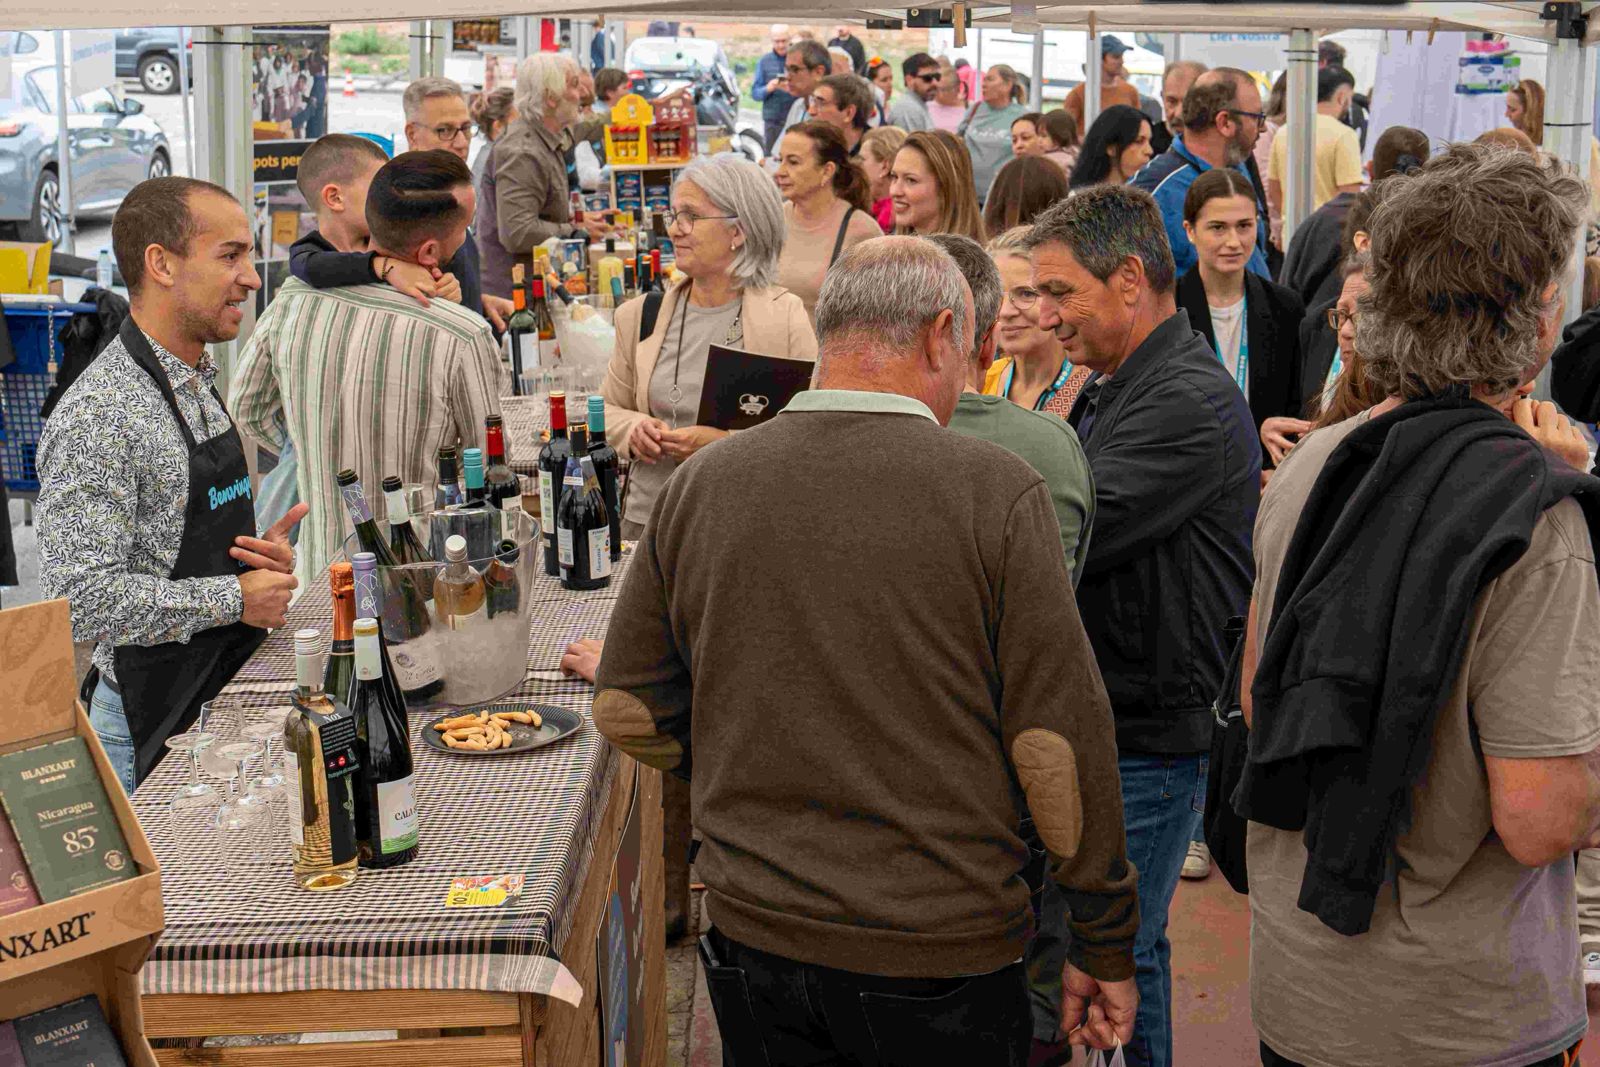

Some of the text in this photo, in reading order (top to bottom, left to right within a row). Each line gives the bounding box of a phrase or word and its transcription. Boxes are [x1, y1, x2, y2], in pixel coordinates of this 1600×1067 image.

[253, 155, 279, 171] pots
[21, 759, 76, 780] BLANXART
[38, 801, 94, 822] Nicaragua
[34, 1020, 88, 1045] BLANXART
